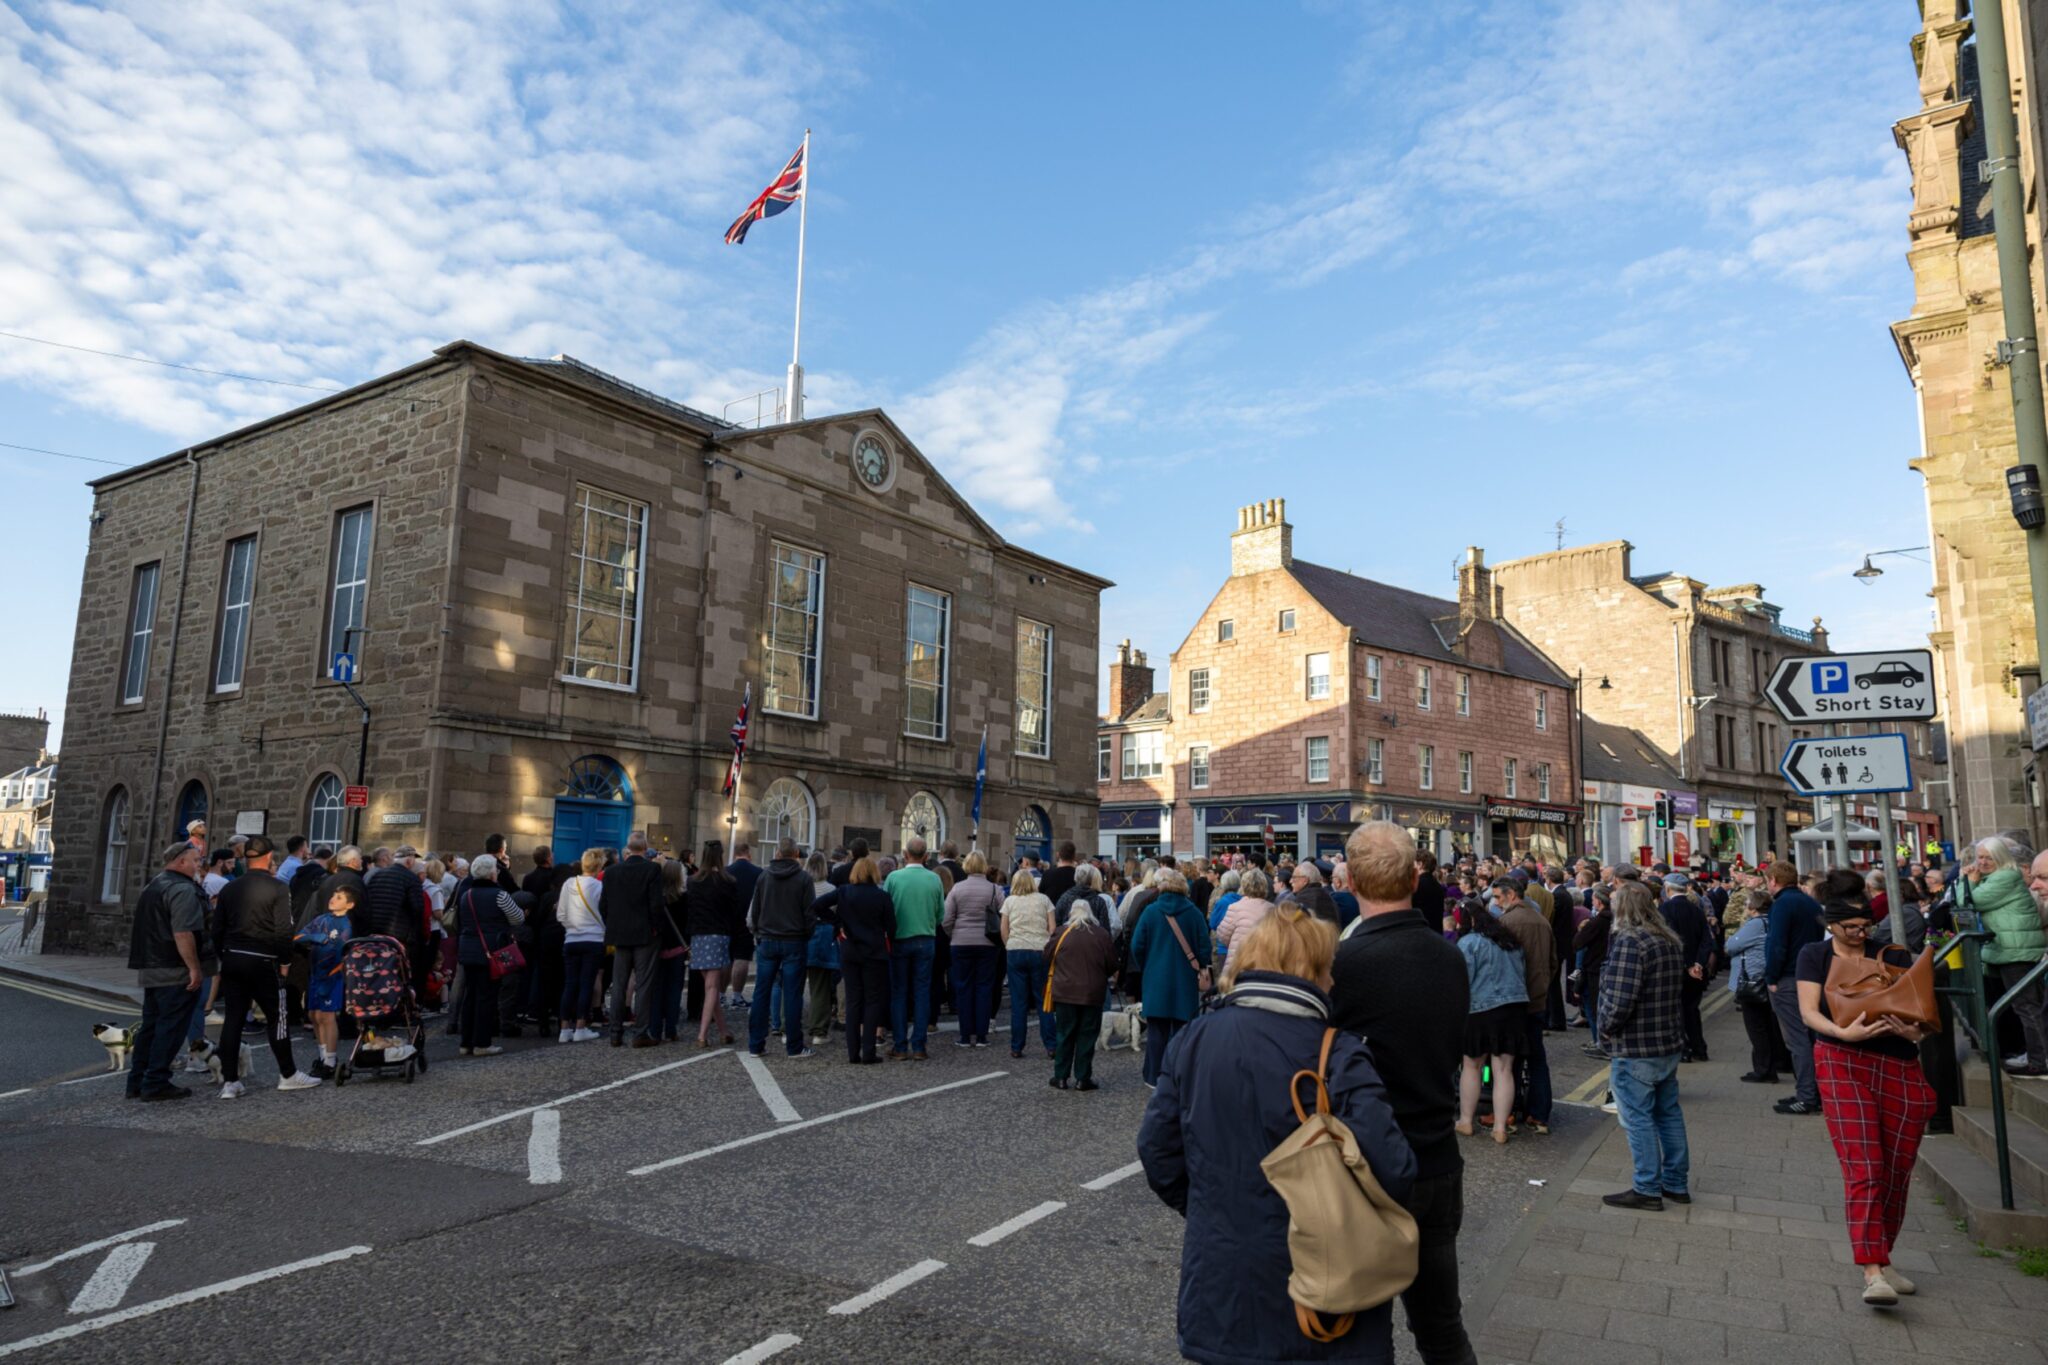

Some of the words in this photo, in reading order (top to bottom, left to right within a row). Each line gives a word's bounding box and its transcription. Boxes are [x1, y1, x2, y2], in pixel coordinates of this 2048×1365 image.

[1820, 665, 1843, 691] P
[1815, 697, 1871, 712] Short
[1879, 695, 1925, 711] Stay
[1815, 745, 1867, 758] Toilets
[1511, 807, 1539, 819] TURKISH
[1540, 810, 1566, 822] BARBER
